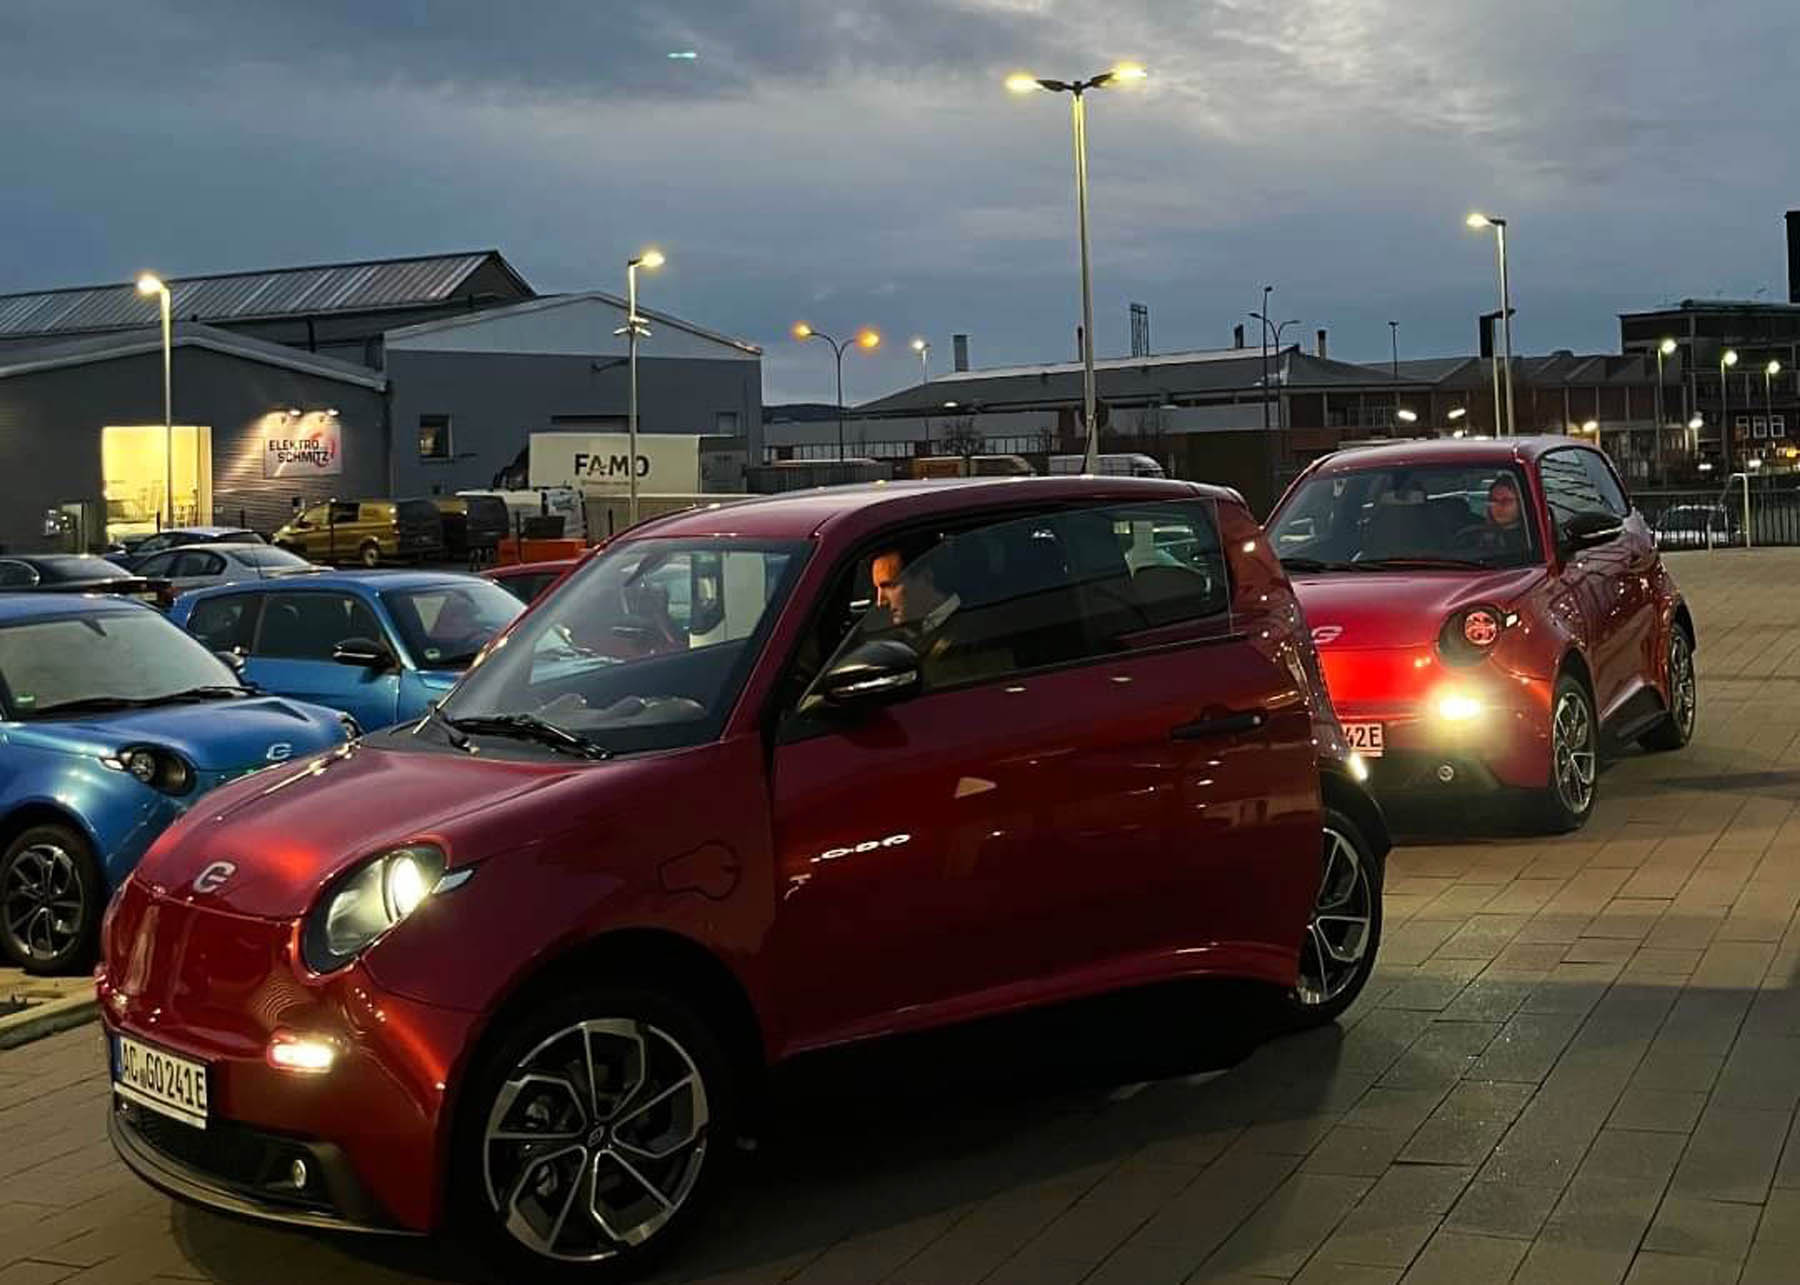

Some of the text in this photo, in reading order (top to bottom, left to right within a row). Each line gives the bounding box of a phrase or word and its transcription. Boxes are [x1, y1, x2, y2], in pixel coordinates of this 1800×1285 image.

[269, 439, 319, 451] ELEKTRO
[277, 451, 330, 464] SCHMITZ
[574, 453, 650, 477] FAMO
